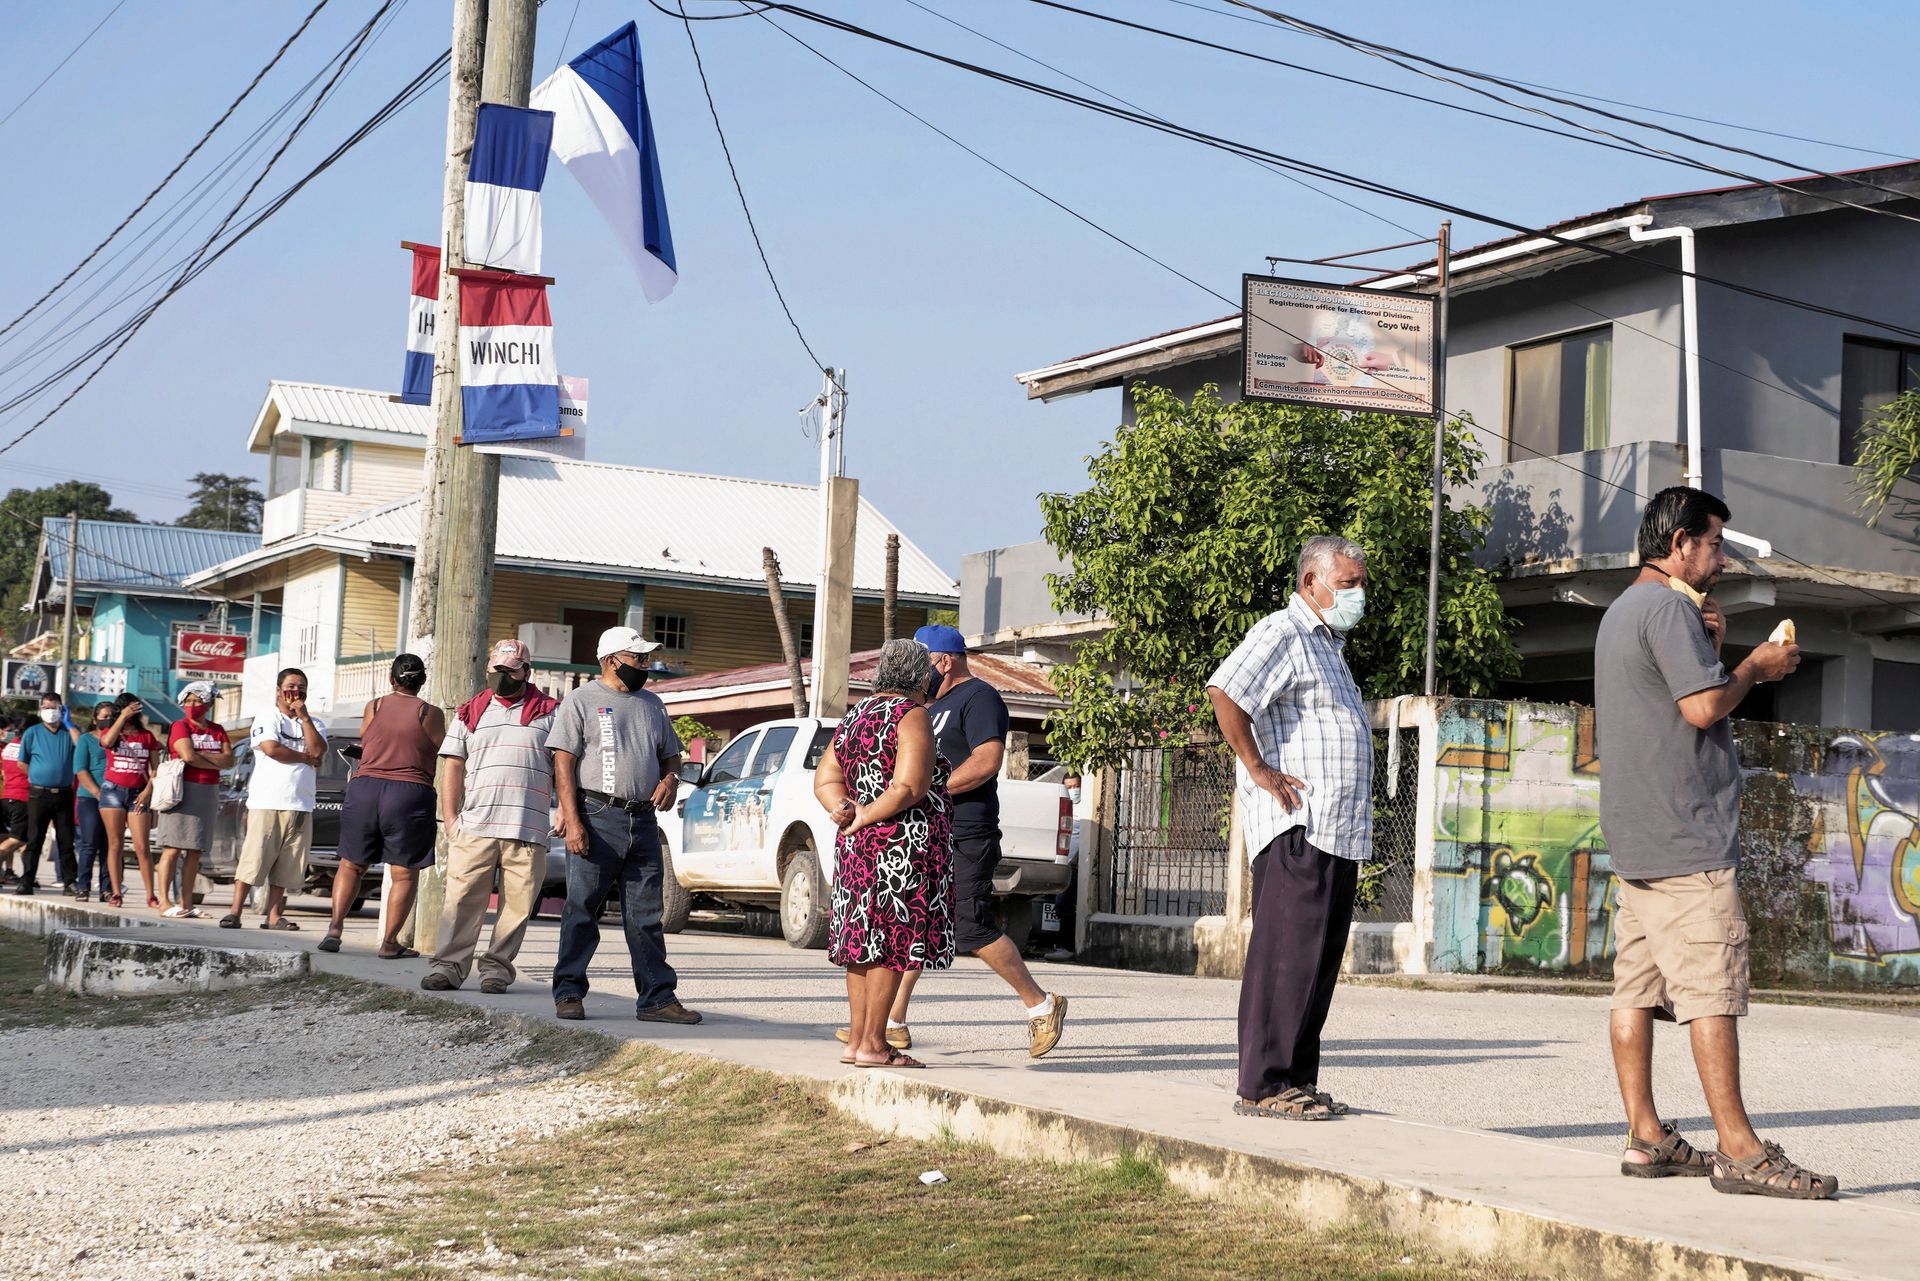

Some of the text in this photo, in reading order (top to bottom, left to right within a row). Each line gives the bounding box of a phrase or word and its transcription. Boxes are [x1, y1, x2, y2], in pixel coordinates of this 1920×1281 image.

[1255, 288, 1428, 314] ELECTIONS AND BOUNDARIES DEPARTMENT
[1269, 298, 1413, 320] Registration office for Electoral Division:
[1377, 320, 1421, 332] Cayo West
[470, 341, 541, 365] WINCHI
[1254, 351, 1289, 361] Telephone:
[1259, 381, 1299, 392] Committed
[1323, 387, 1370, 396] enhancement
[1380, 390, 1419, 402] Democracy
[186, 670, 238, 680] MINI STORE
[598, 715, 615, 747] MORE
[602, 750, 616, 794] EXPECT
